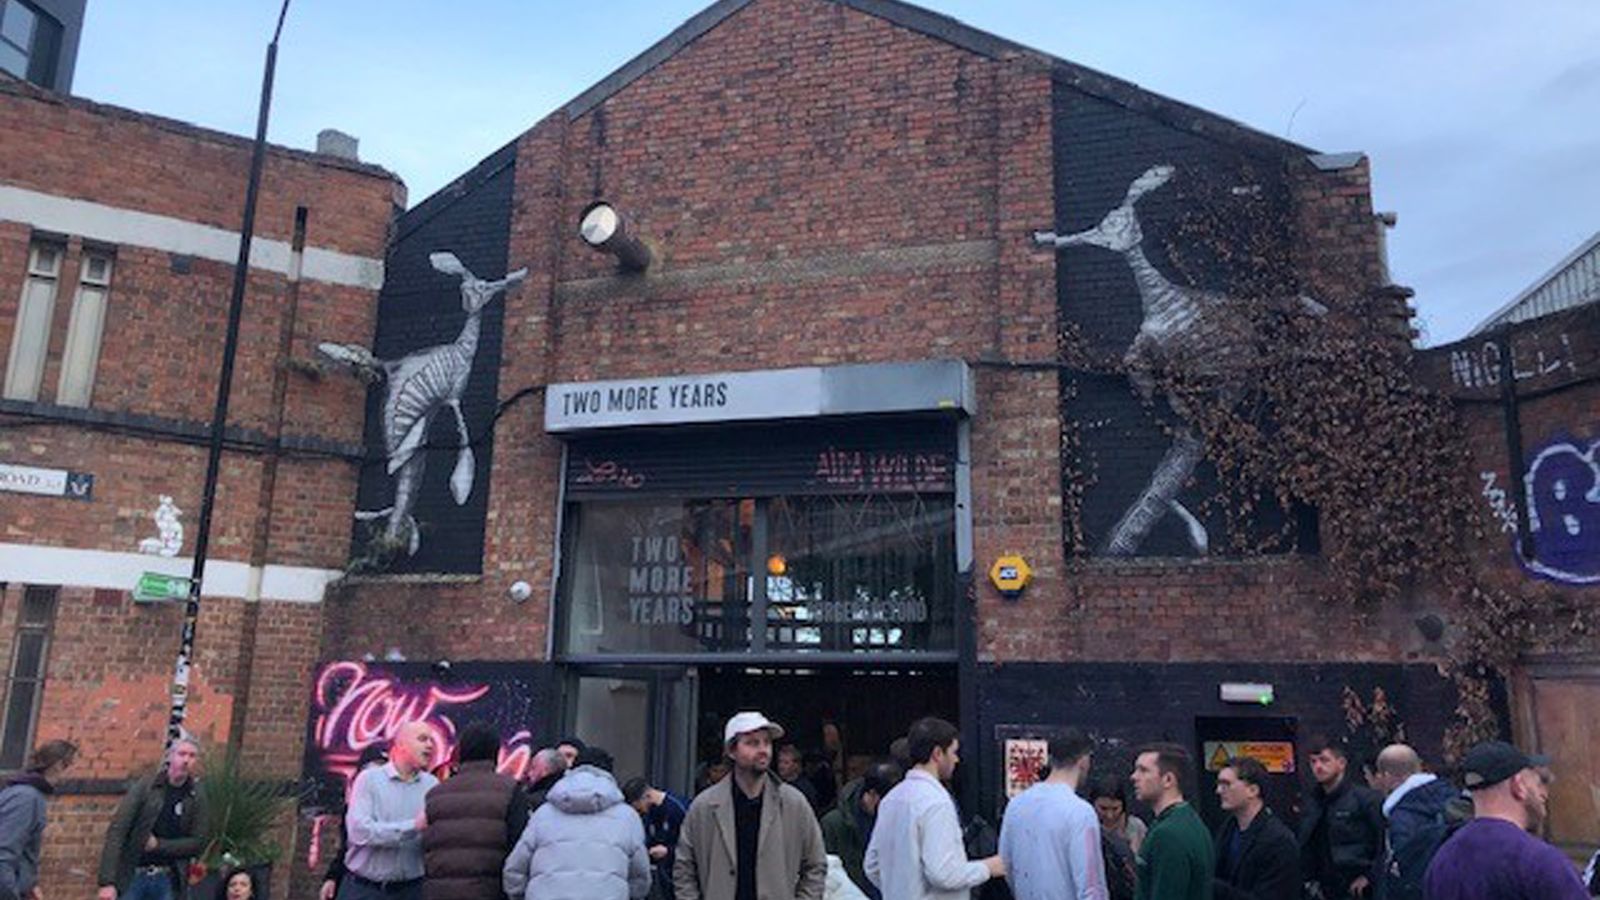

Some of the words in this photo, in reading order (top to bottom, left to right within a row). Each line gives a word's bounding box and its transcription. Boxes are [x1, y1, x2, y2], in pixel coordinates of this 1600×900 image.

[563, 390, 600, 416] TWO
[607, 386, 658, 412] MORE
[669, 381, 728, 408] YEARS
[631, 536, 679, 562] TWO
[629, 566, 694, 593] MORE
[630, 597, 694, 624] YEARS
